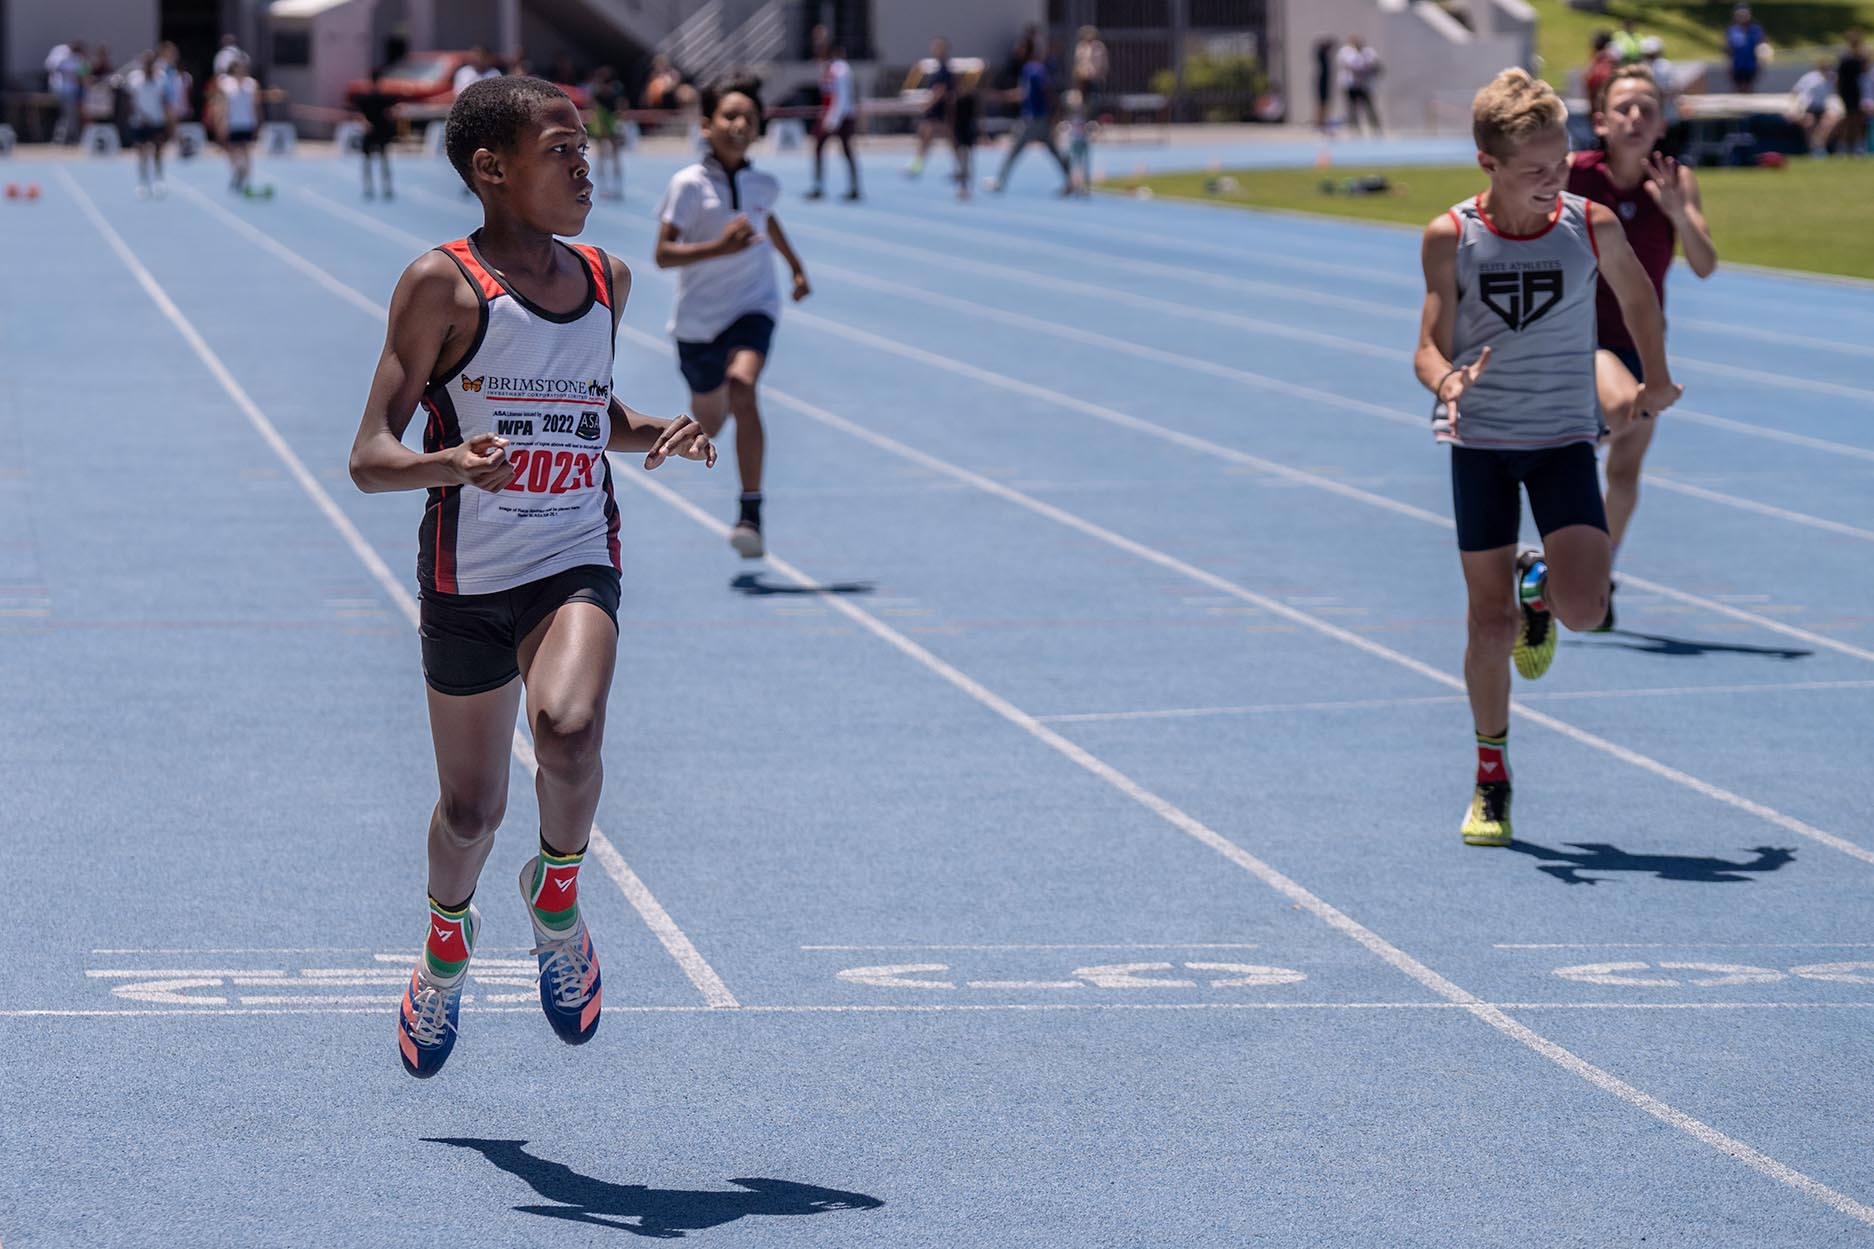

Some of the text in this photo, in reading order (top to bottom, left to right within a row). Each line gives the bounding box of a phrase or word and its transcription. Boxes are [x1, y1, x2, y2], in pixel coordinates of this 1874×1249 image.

[487, 376, 587, 394] BRIMSTONE
[498, 420, 533, 435] WPA
[542, 414, 574, 433] 2022
[580, 414, 600, 429] ASA
